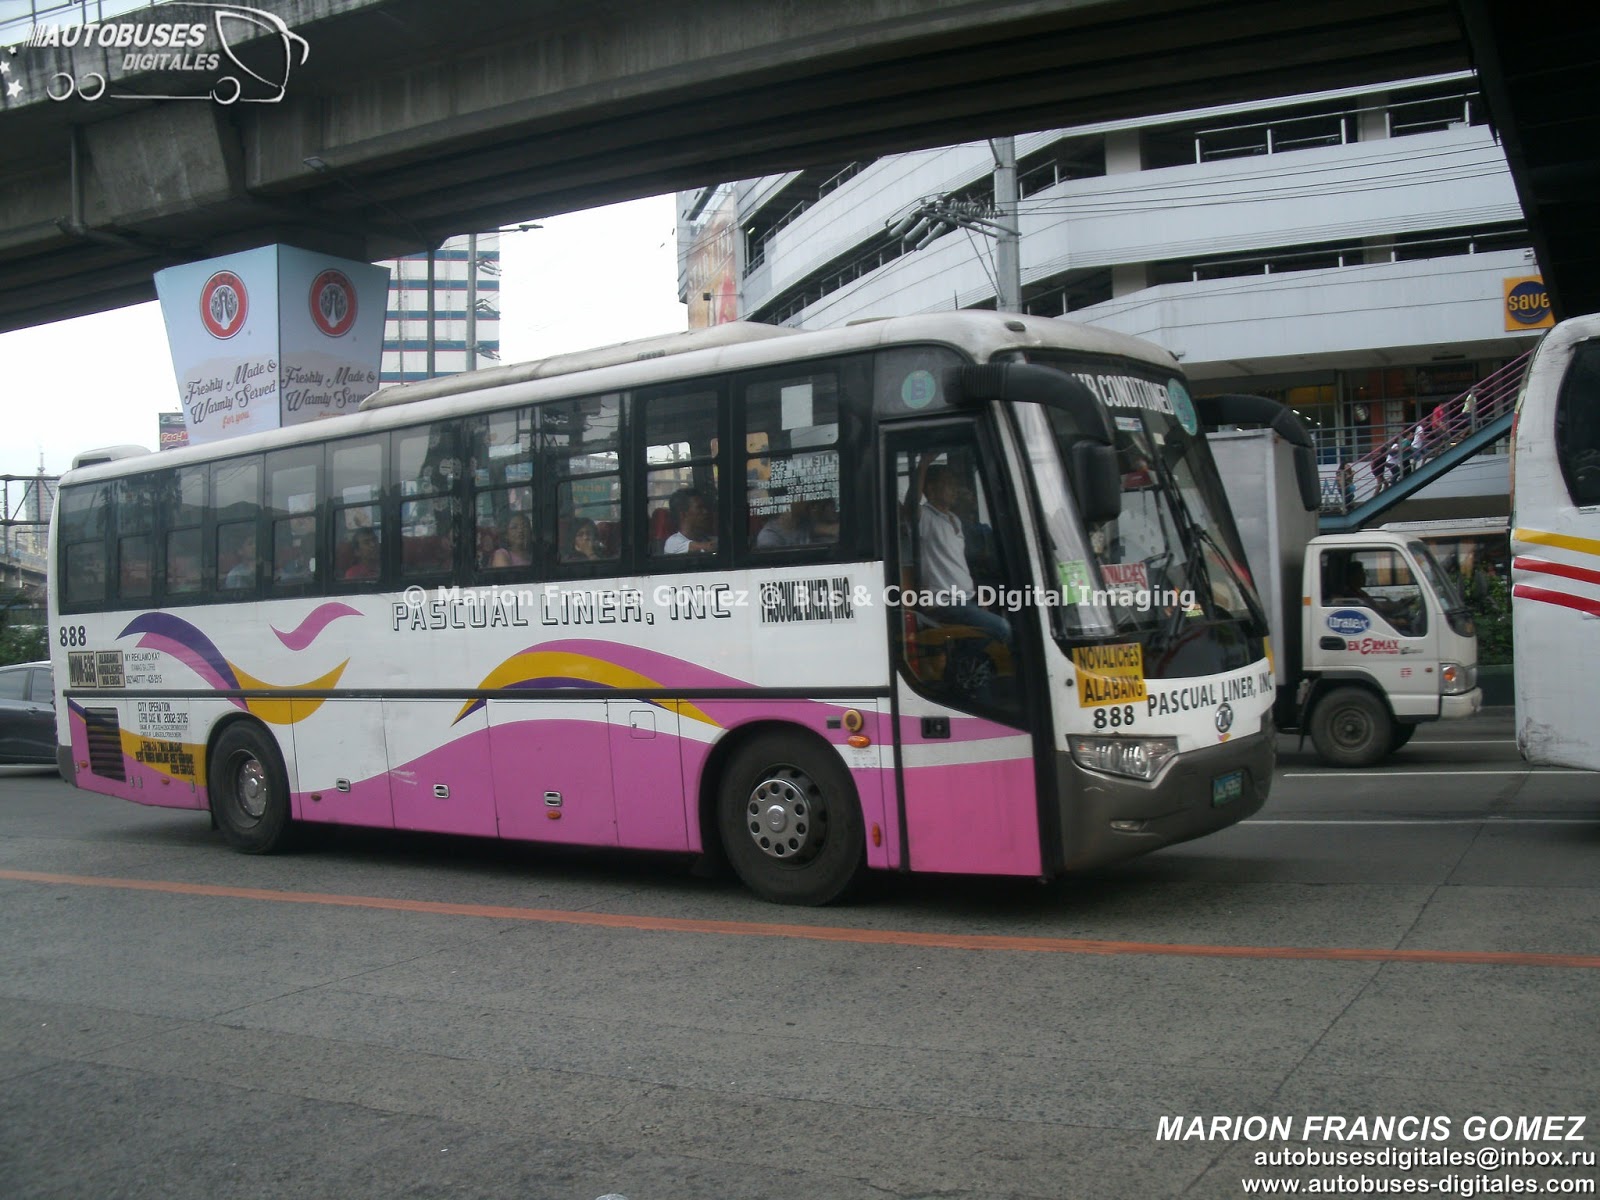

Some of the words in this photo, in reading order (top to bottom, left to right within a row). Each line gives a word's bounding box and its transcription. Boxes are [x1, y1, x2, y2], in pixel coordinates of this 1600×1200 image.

[185, 377, 223, 405] Freshly
[226, 362, 264, 390] Made
[268, 359, 277, 373] &
[281, 366, 324, 389] Freshly
[327, 366, 364, 389] Made
[366, 370, 376, 383] &
[190, 396, 234, 425] Warmly
[235, 379, 276, 408] Served
[285, 388, 332, 412] Warmly
[392, 595, 528, 631] PASCUAL
[540, 587, 655, 626] LINER,
[668, 583, 731, 620] INC
[59, 625, 87, 647] 888
[1077, 642, 1141, 671] NOVALICHES
[1083, 673, 1143, 703] ALABANG
[1147, 684, 1218, 717] PASCUAL
[1220, 676, 1258, 704] LINER,
[1093, 704, 1136, 729] 888
